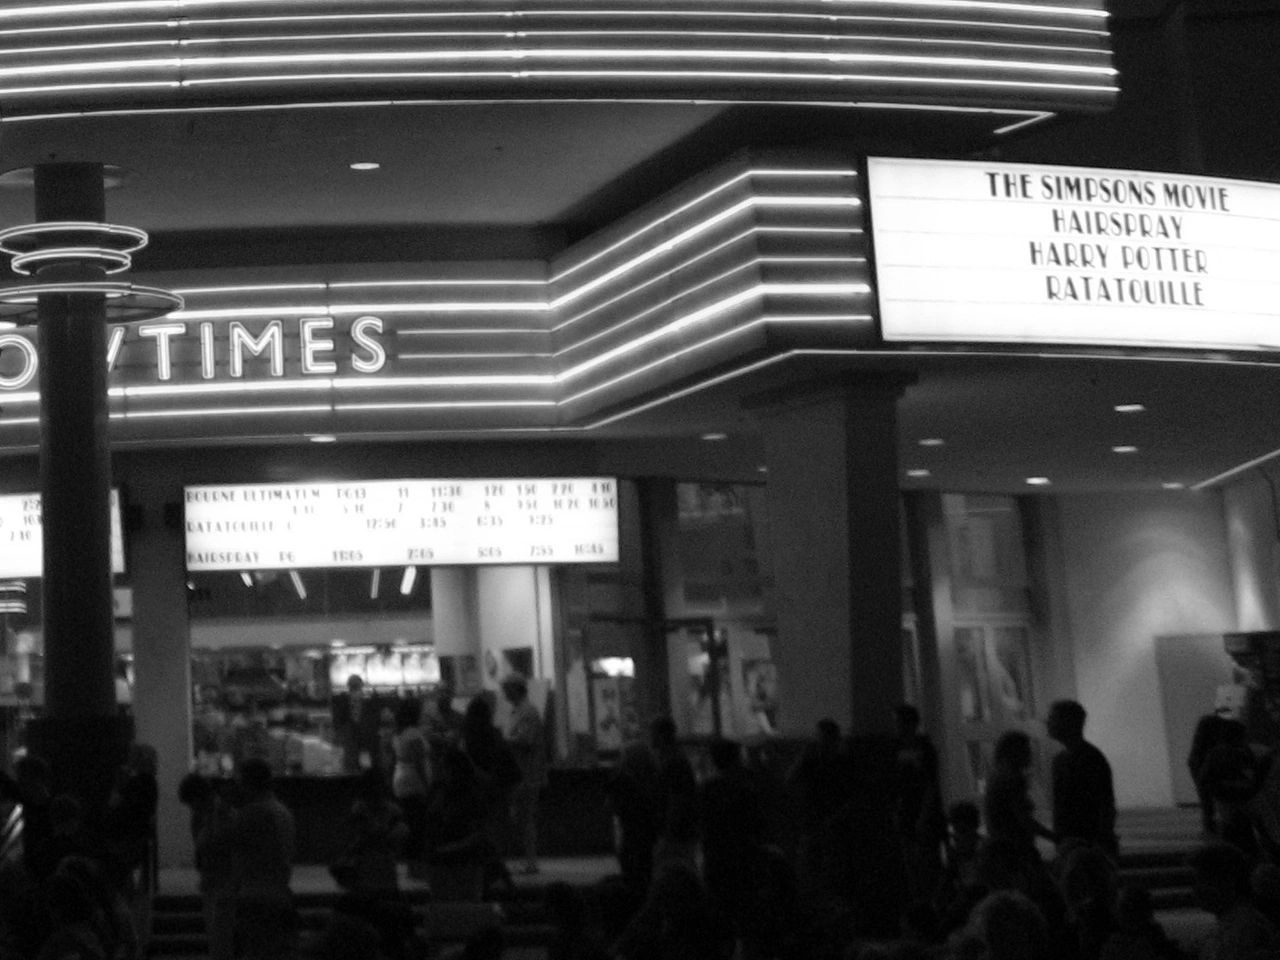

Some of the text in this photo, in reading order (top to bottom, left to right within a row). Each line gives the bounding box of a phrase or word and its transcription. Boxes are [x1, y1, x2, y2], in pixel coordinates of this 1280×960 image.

[985, 171, 1231, 212] THE SIMPSONS MOVIE
[1051, 208, 1183, 240] HAIRSPRAY
[1029, 240, 1209, 274] HARRY POTTER
[1045, 274, 1205, 307] RATATOUILLE
